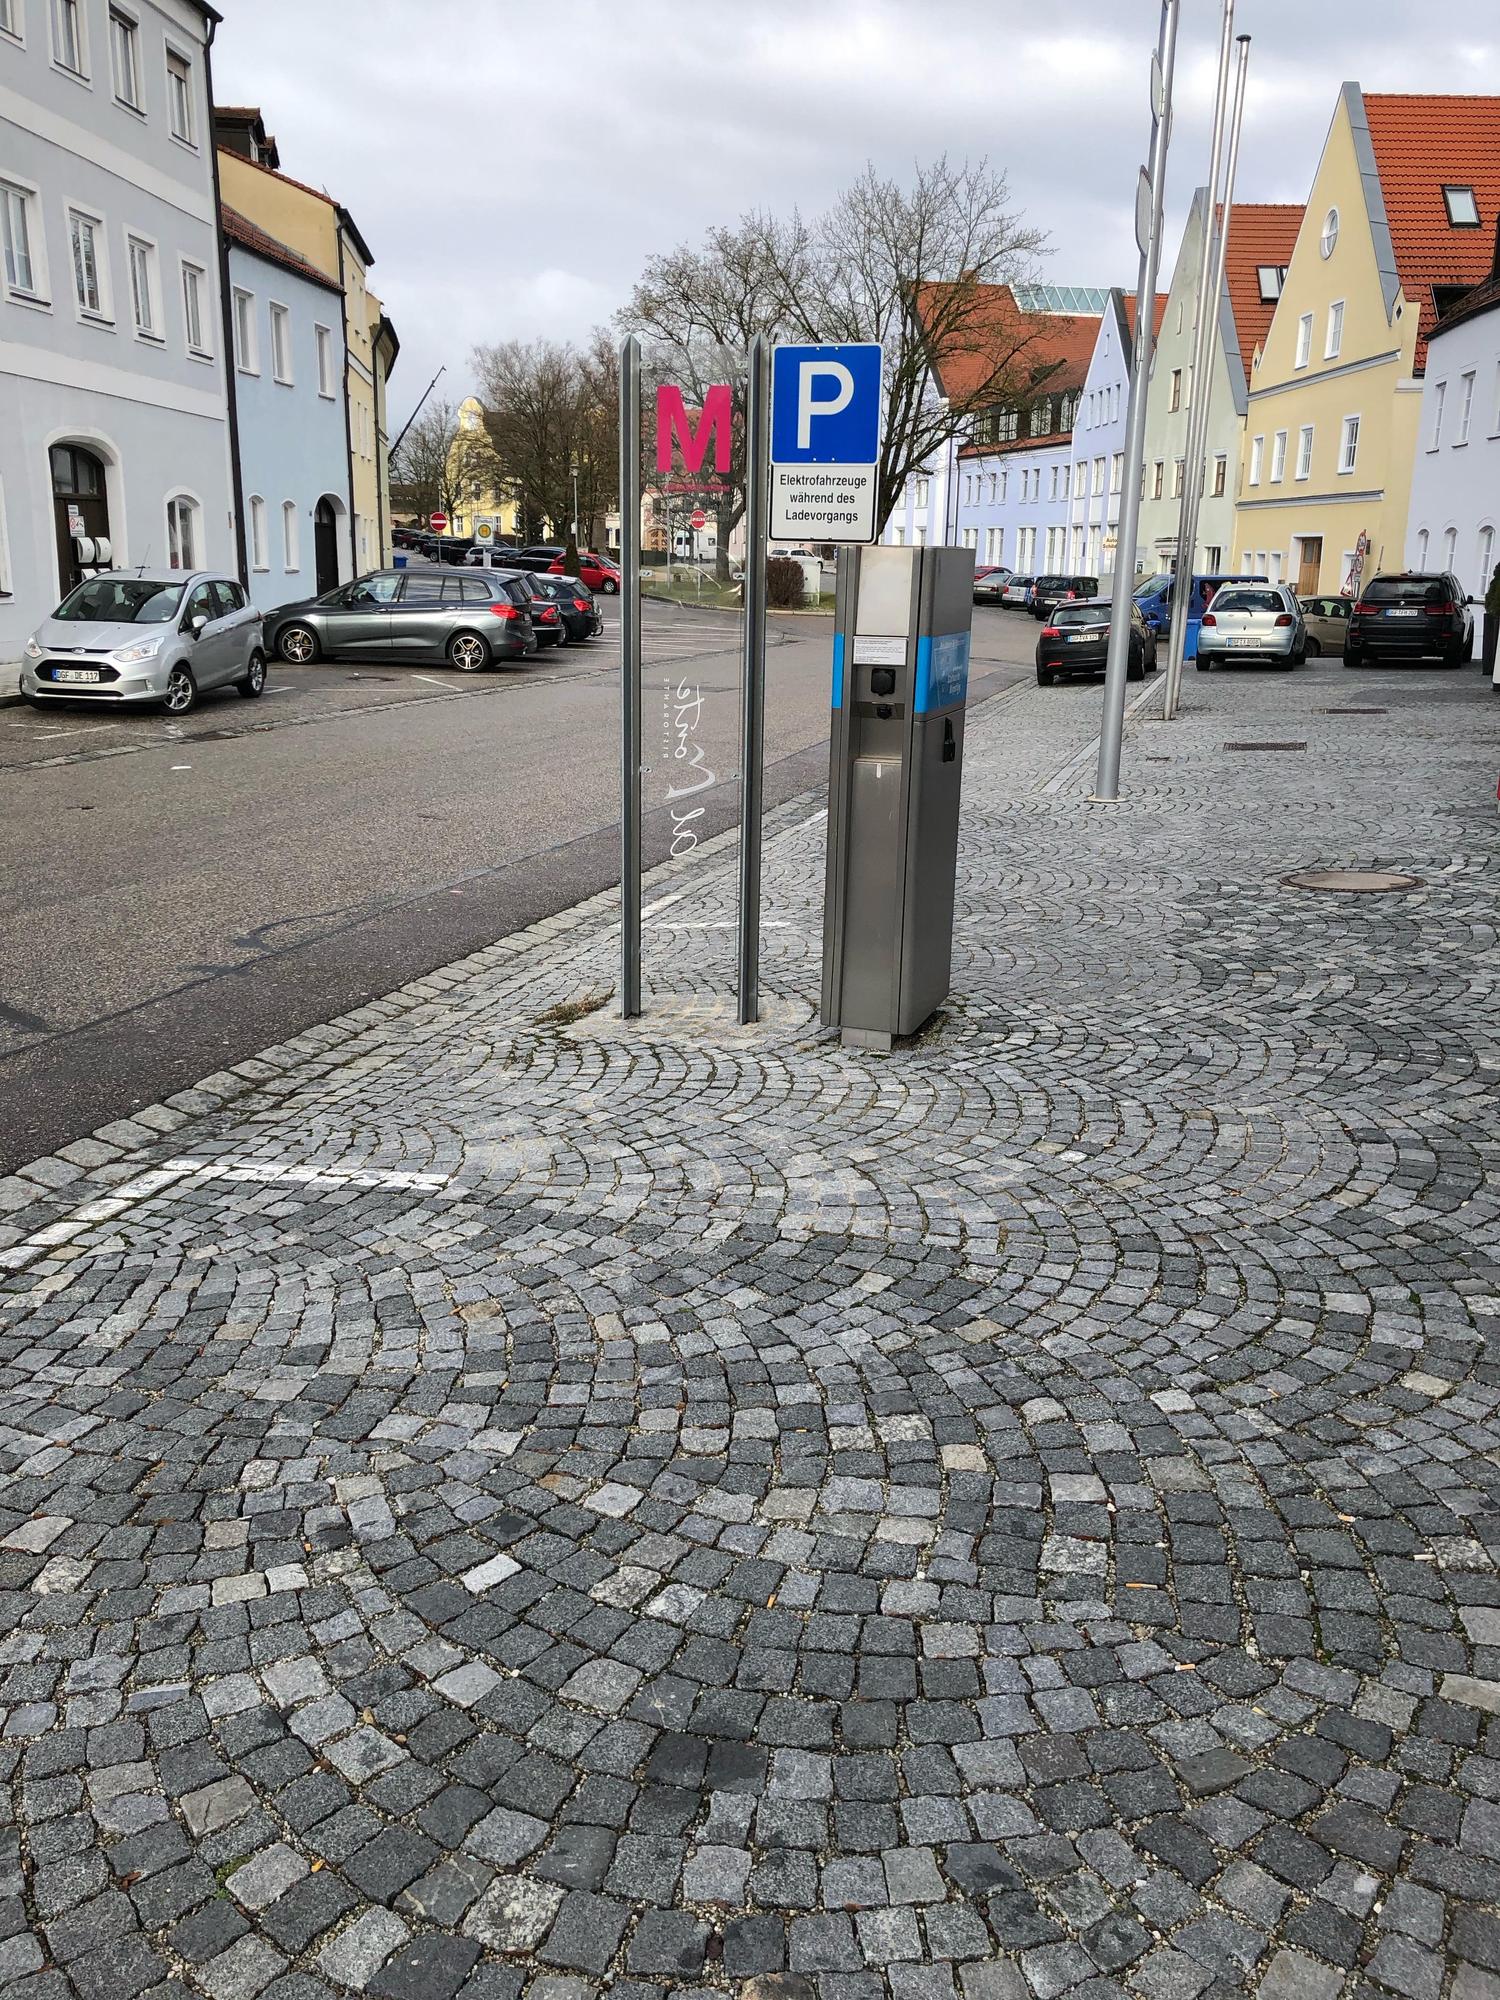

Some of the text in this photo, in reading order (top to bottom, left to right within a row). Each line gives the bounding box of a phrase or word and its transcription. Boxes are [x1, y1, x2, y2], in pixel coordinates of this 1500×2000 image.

[797, 361, 854, 449] P
[657, 384, 732, 473] M
[780, 474, 867, 489] Elektrofahrzeuge
[790, 492, 855, 504] während des
[785, 509, 858, 524] Ladevorgangs
